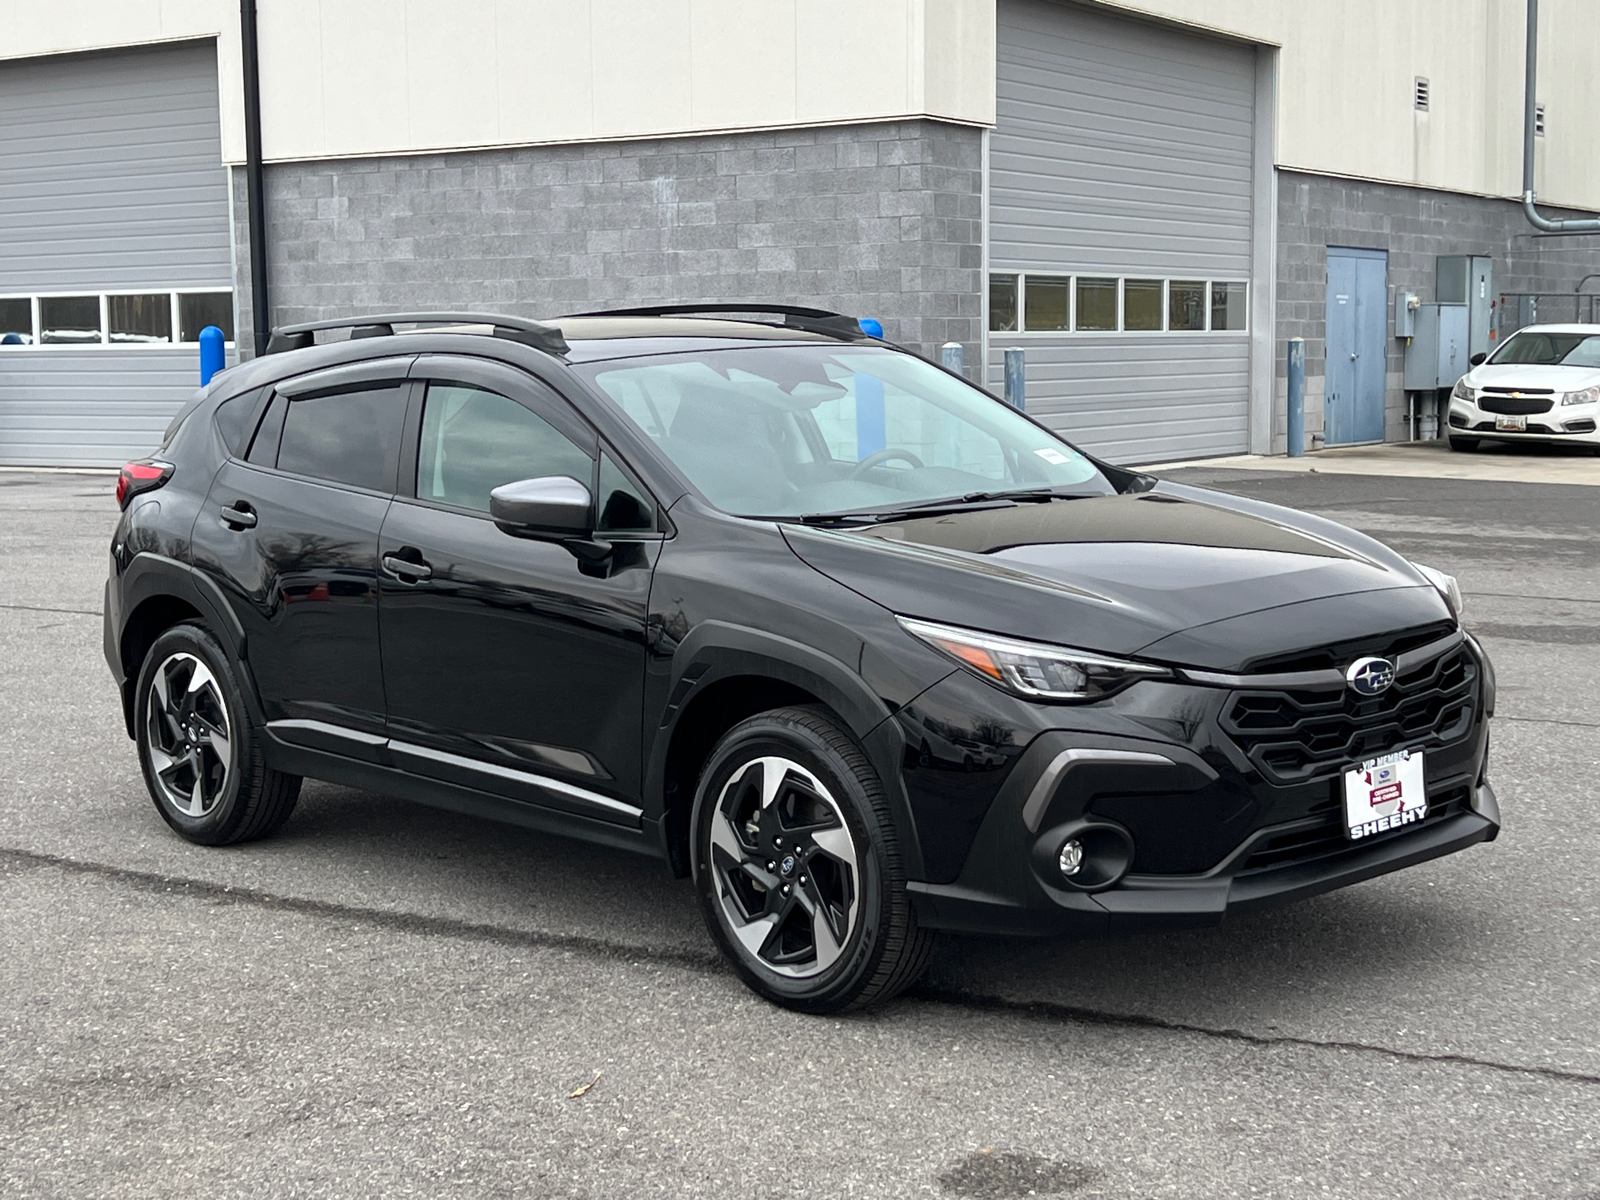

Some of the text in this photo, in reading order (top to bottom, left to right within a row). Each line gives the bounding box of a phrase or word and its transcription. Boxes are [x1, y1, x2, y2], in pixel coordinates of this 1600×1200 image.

[1362, 749, 1409, 770] VIP MEMBER
[1350, 805, 1427, 839] SHEEHY
